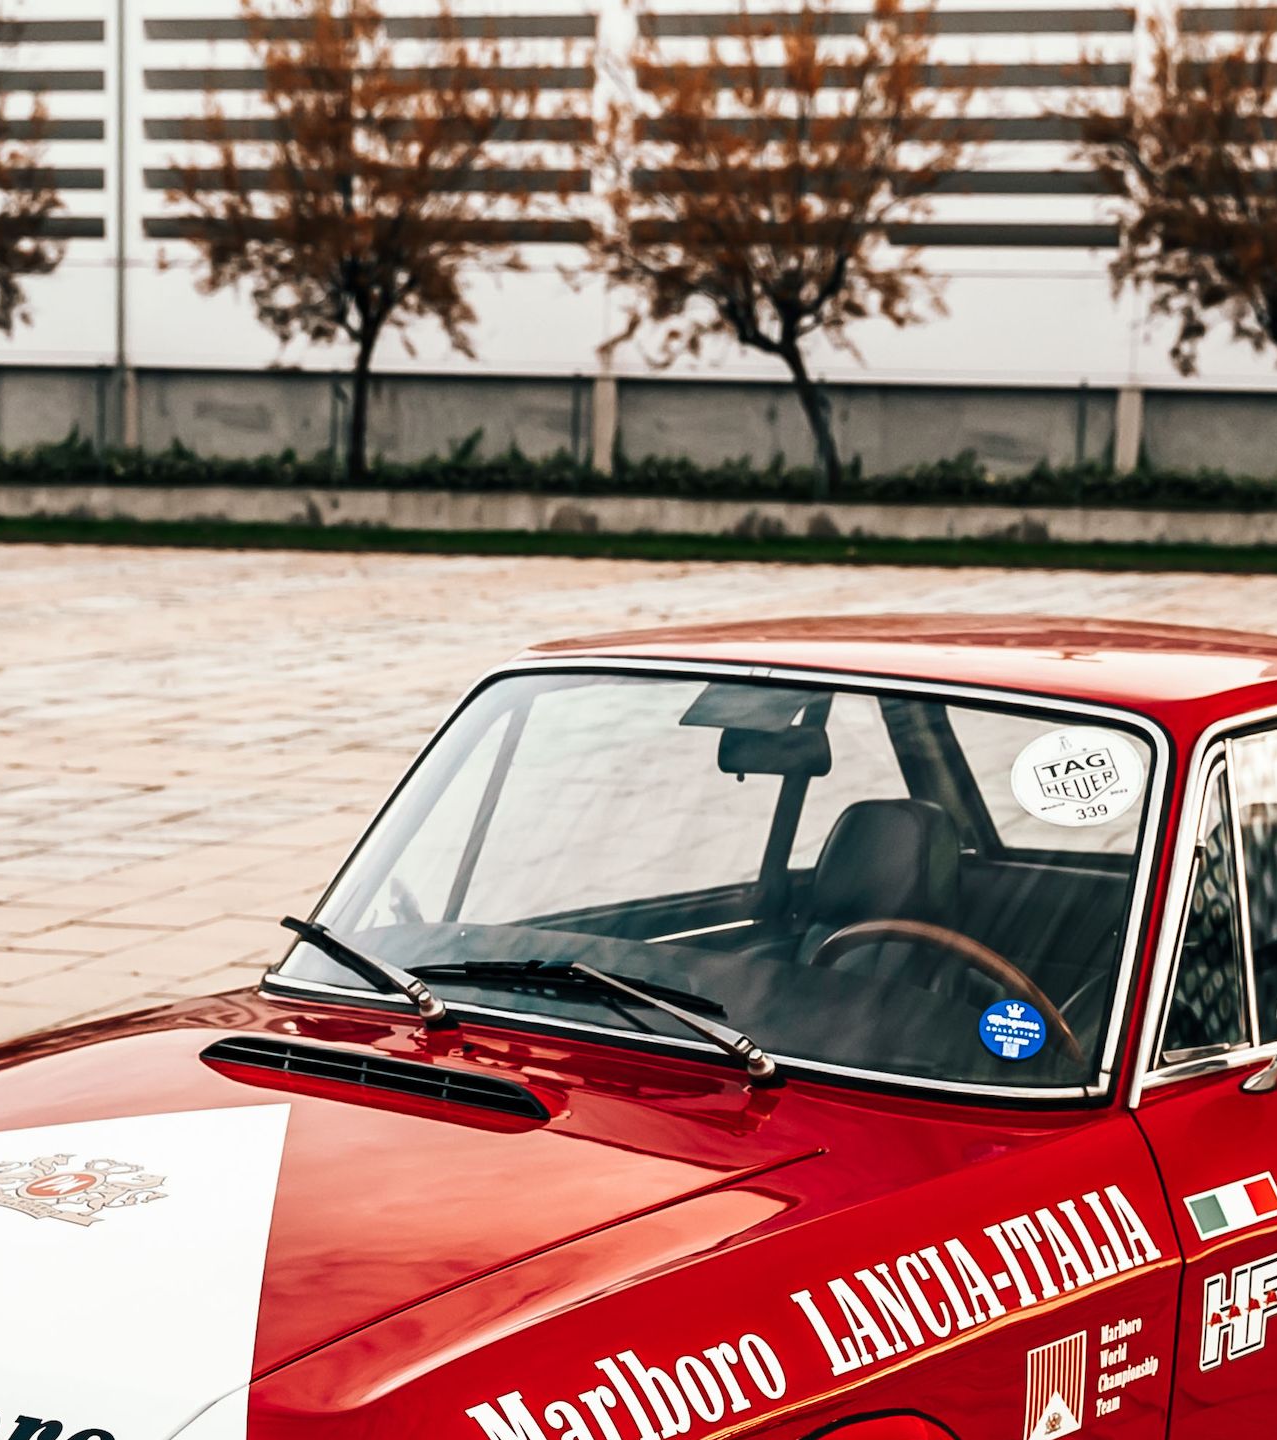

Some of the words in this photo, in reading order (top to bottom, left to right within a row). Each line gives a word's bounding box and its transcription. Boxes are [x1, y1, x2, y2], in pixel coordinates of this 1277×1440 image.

[1042, 753, 1106, 778] TAG
[1045, 770, 1114, 800] HEUER
[1076, 804, 1108, 820] 339
[791, 1185, 1162, 1377] LANCIA-ITALIA
[1101, 1317, 1143, 1345] Marlboro
[1100, 1342, 1128, 1369] World
[1098, 1356, 1159, 1393] Championship
[1096, 1396, 1121, 1418] Team
